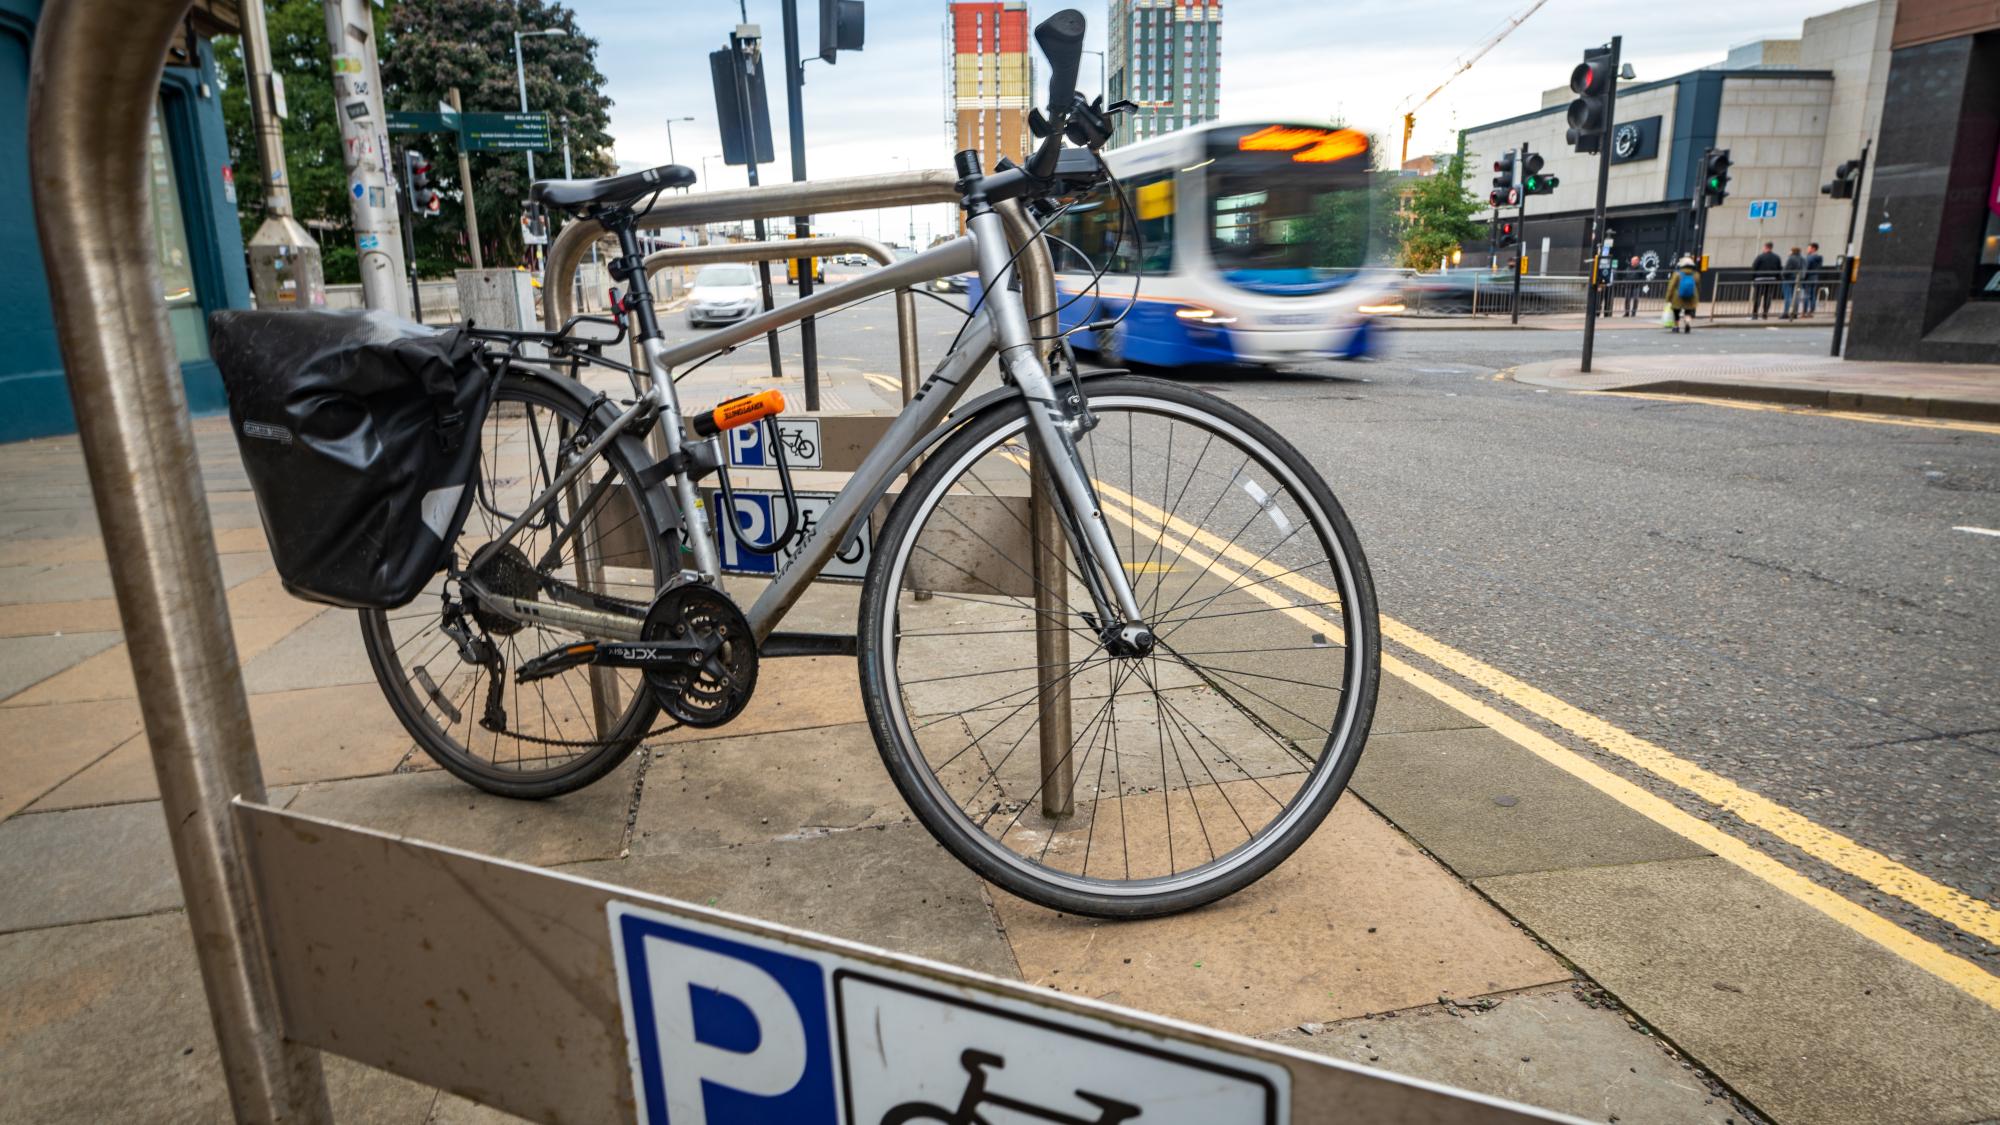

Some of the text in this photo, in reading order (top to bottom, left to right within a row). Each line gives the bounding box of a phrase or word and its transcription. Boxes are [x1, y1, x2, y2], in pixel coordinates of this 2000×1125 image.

[732, 423, 760, 464] P
[720, 498, 765, 566] P
[774, 529, 817, 585] MARIN
[623, 648, 657, 660] XCR
[642, 934, 808, 1125] P
